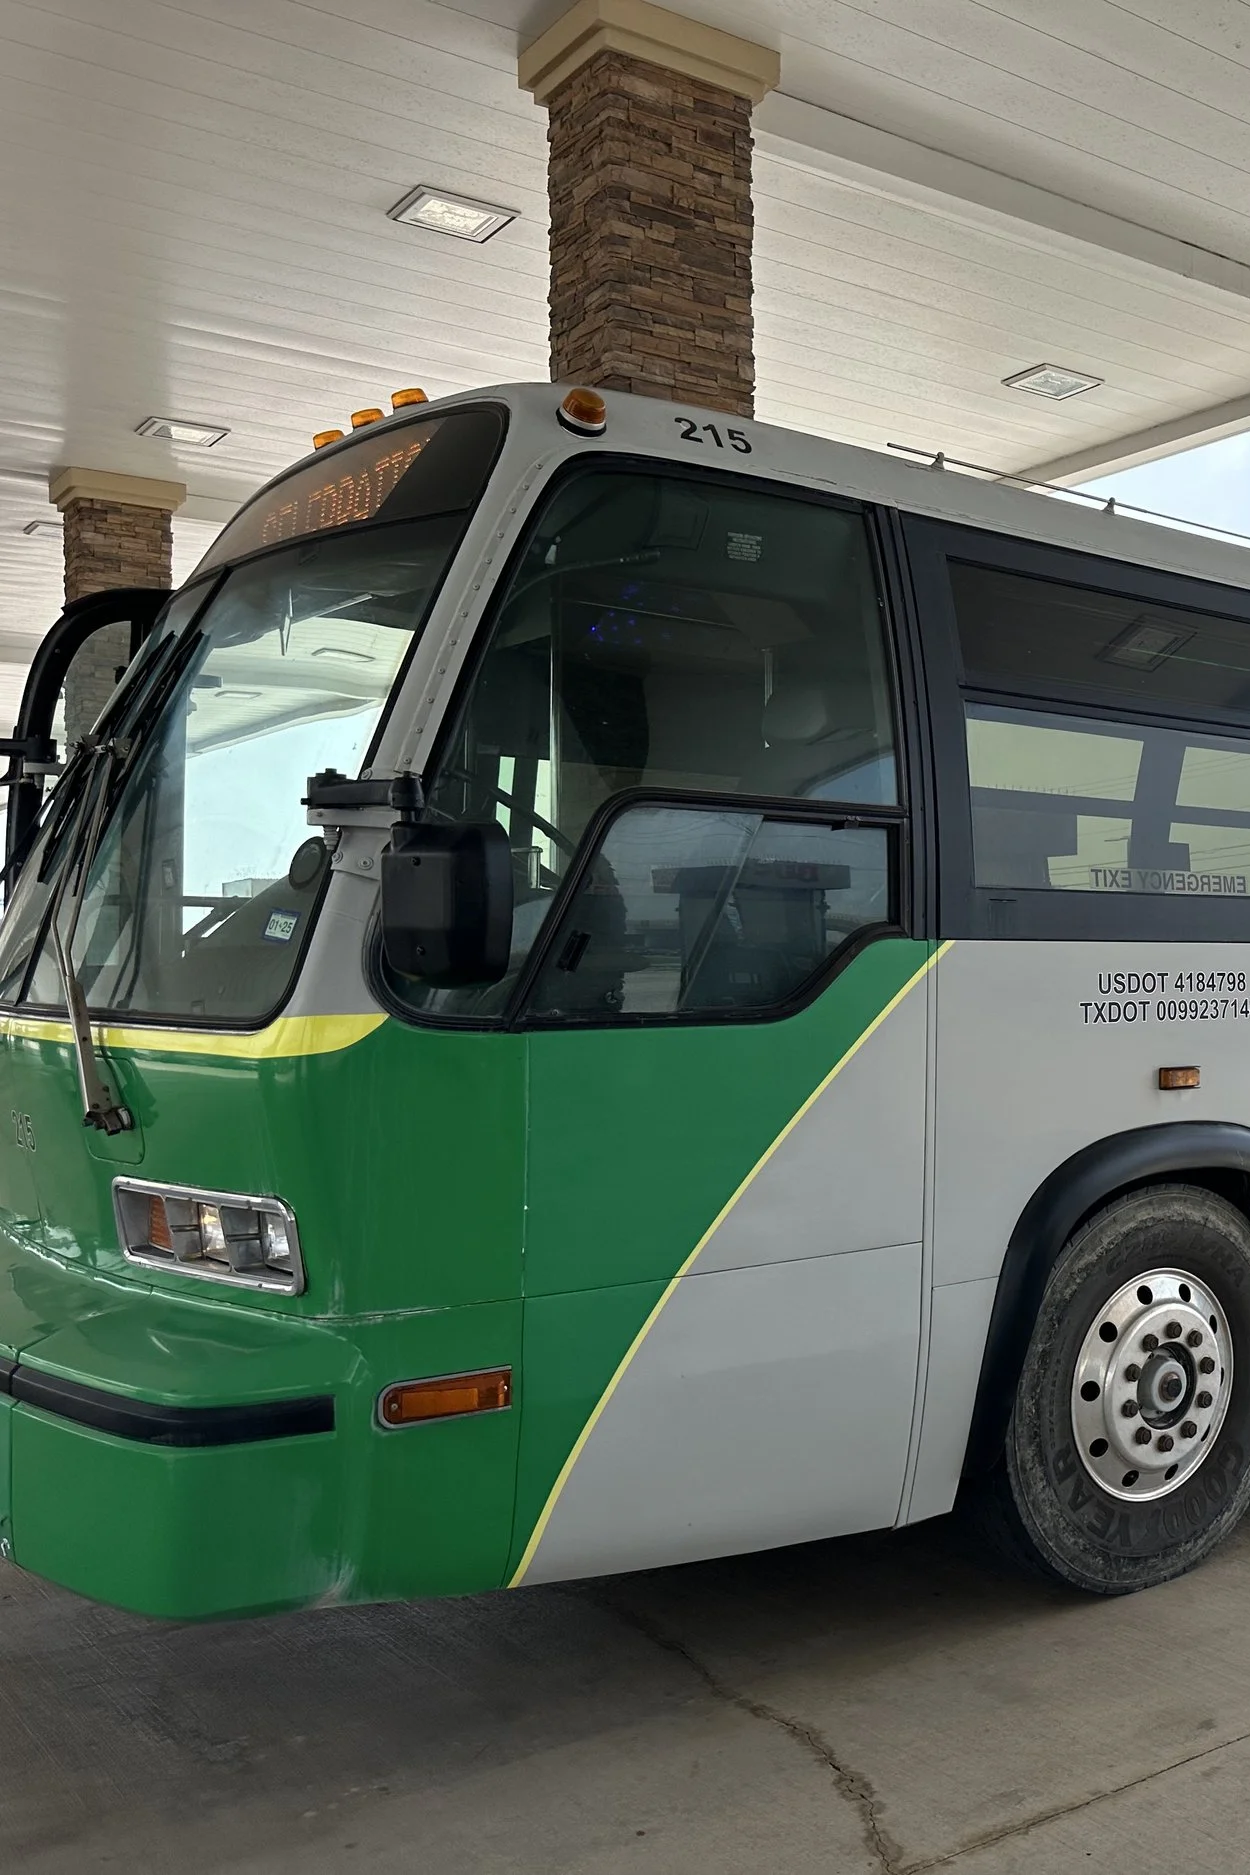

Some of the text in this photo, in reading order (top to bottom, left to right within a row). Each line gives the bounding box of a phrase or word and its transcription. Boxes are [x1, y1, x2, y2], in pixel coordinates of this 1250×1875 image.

[674, 417, 752, 454] 215
[1098, 972, 1247, 995] USDOT 4184798
[1080, 1001, 1151, 1024] TXDOT
[11, 1109, 37, 1152] 215
